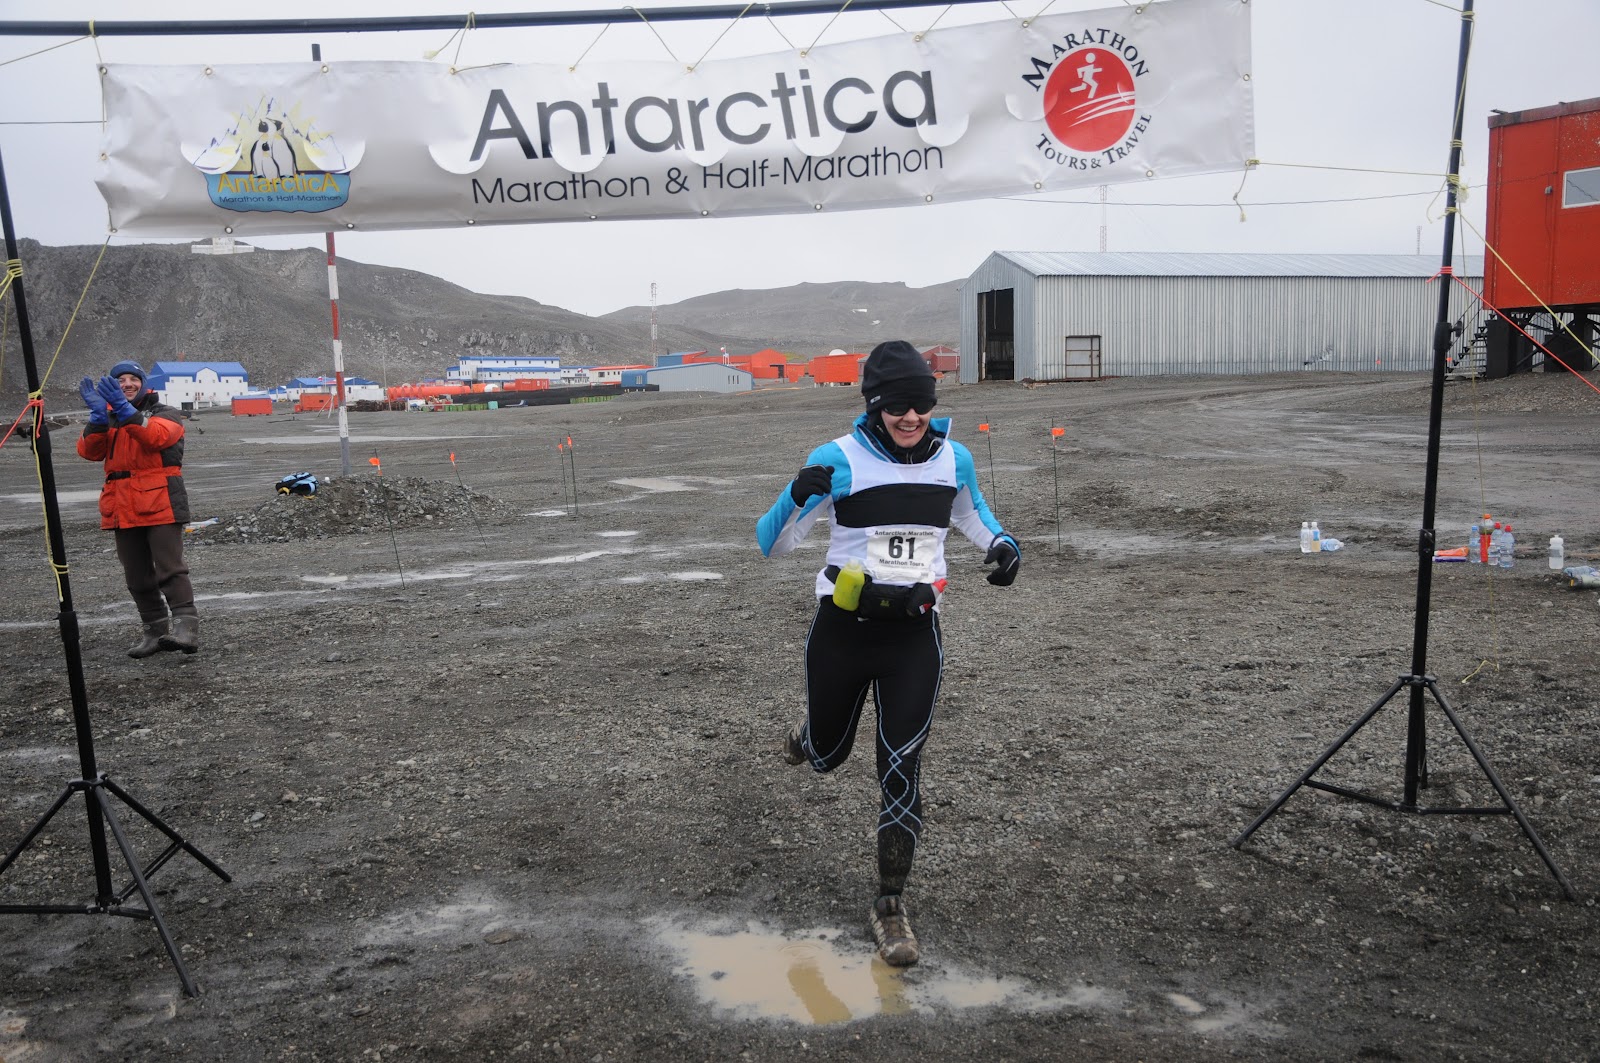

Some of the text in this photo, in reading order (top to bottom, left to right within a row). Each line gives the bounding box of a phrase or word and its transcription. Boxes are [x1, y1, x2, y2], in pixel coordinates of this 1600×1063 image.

[1022, 28, 1149, 92] MARATHON
[469, 69, 937, 162] Antarctica
[1036, 114, 1152, 170] TOURS & TRAVEL
[217, 173, 341, 193] AntarcticA
[219, 195, 264, 203] Marathon
[276, 195, 342, 203] Half-Marathon
[472, 146, 943, 204] Marathon & Half-Marathon
[888, 536, 916, 559] 61
